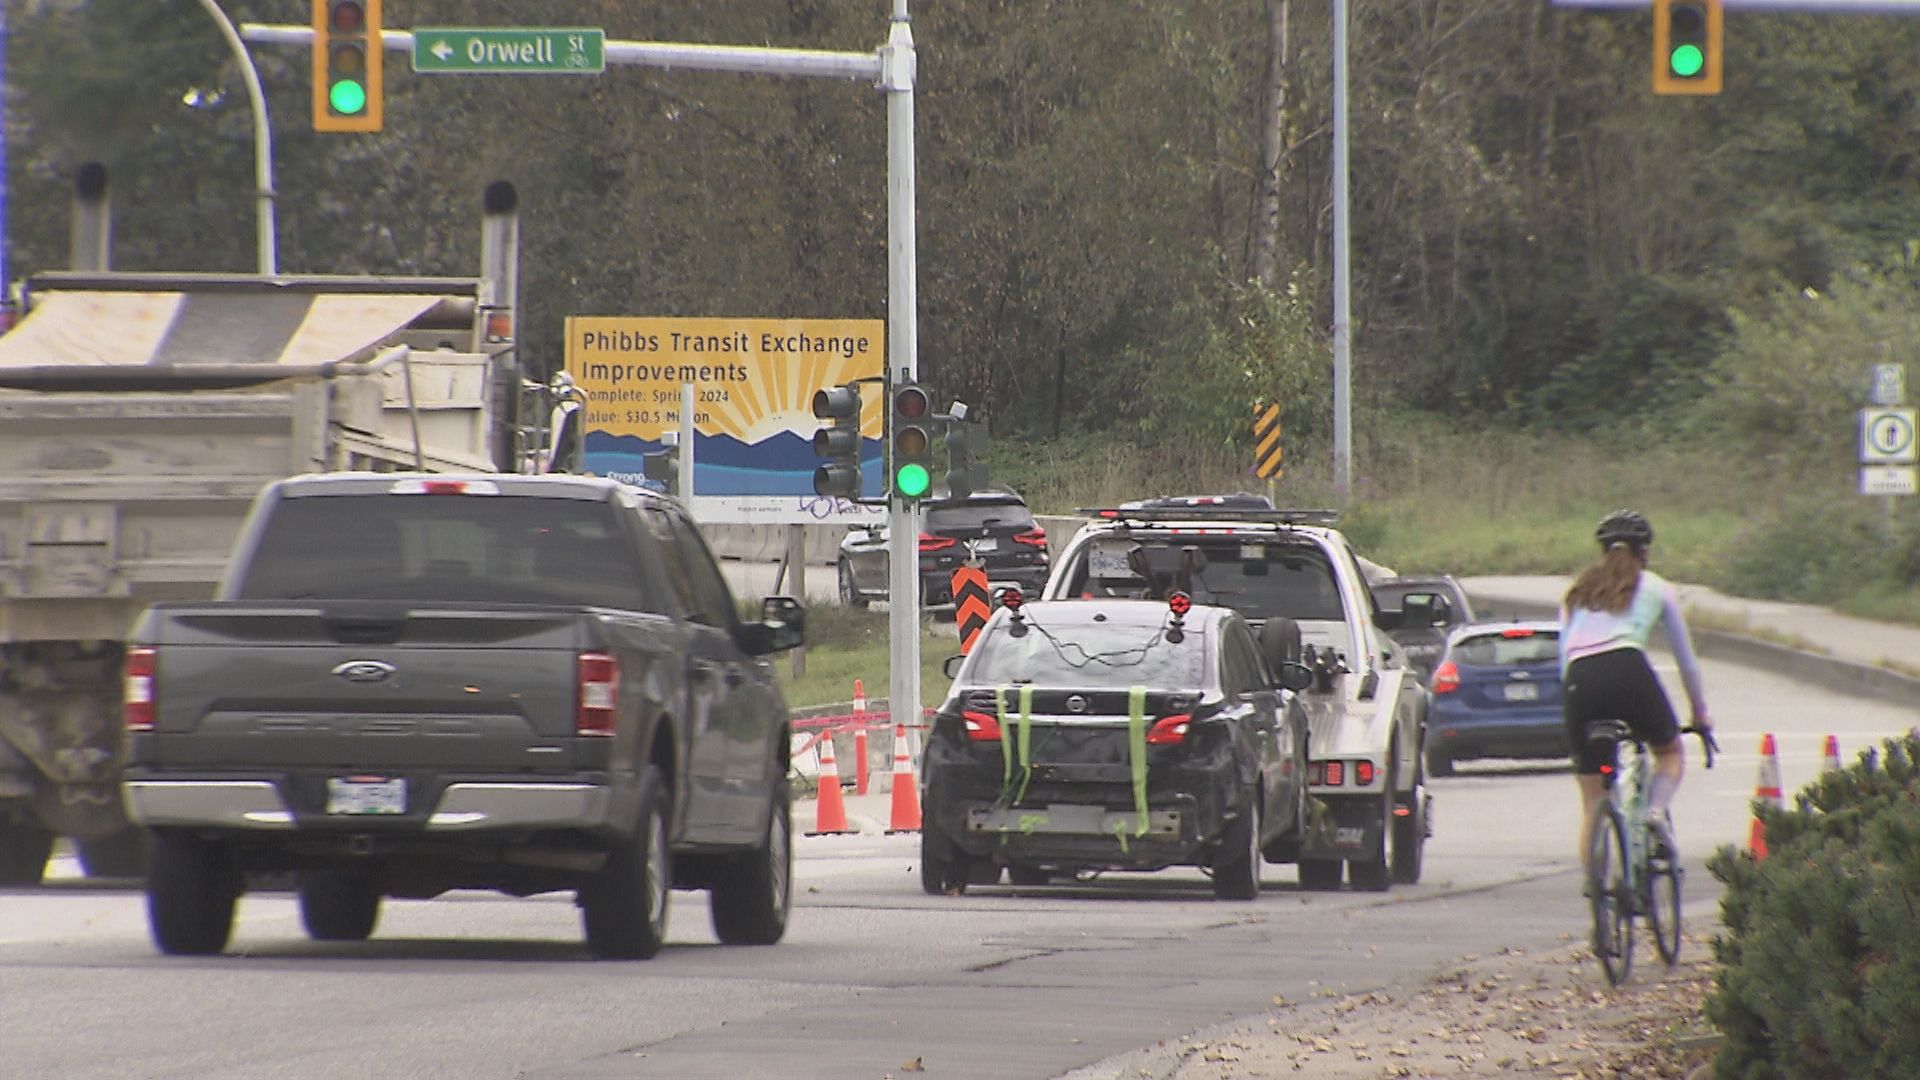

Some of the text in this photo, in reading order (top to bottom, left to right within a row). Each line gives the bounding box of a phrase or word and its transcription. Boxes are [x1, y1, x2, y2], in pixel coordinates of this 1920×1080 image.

[467, 35, 583, 63] Orwell St
[583, 331, 869, 358] Phibbs Transit Exchange
[583, 362, 747, 384] Improvements
[584, 389, 728, 404] omplete: Spri 2024
[587, 410, 709, 424] alue: $30.5 Mion
